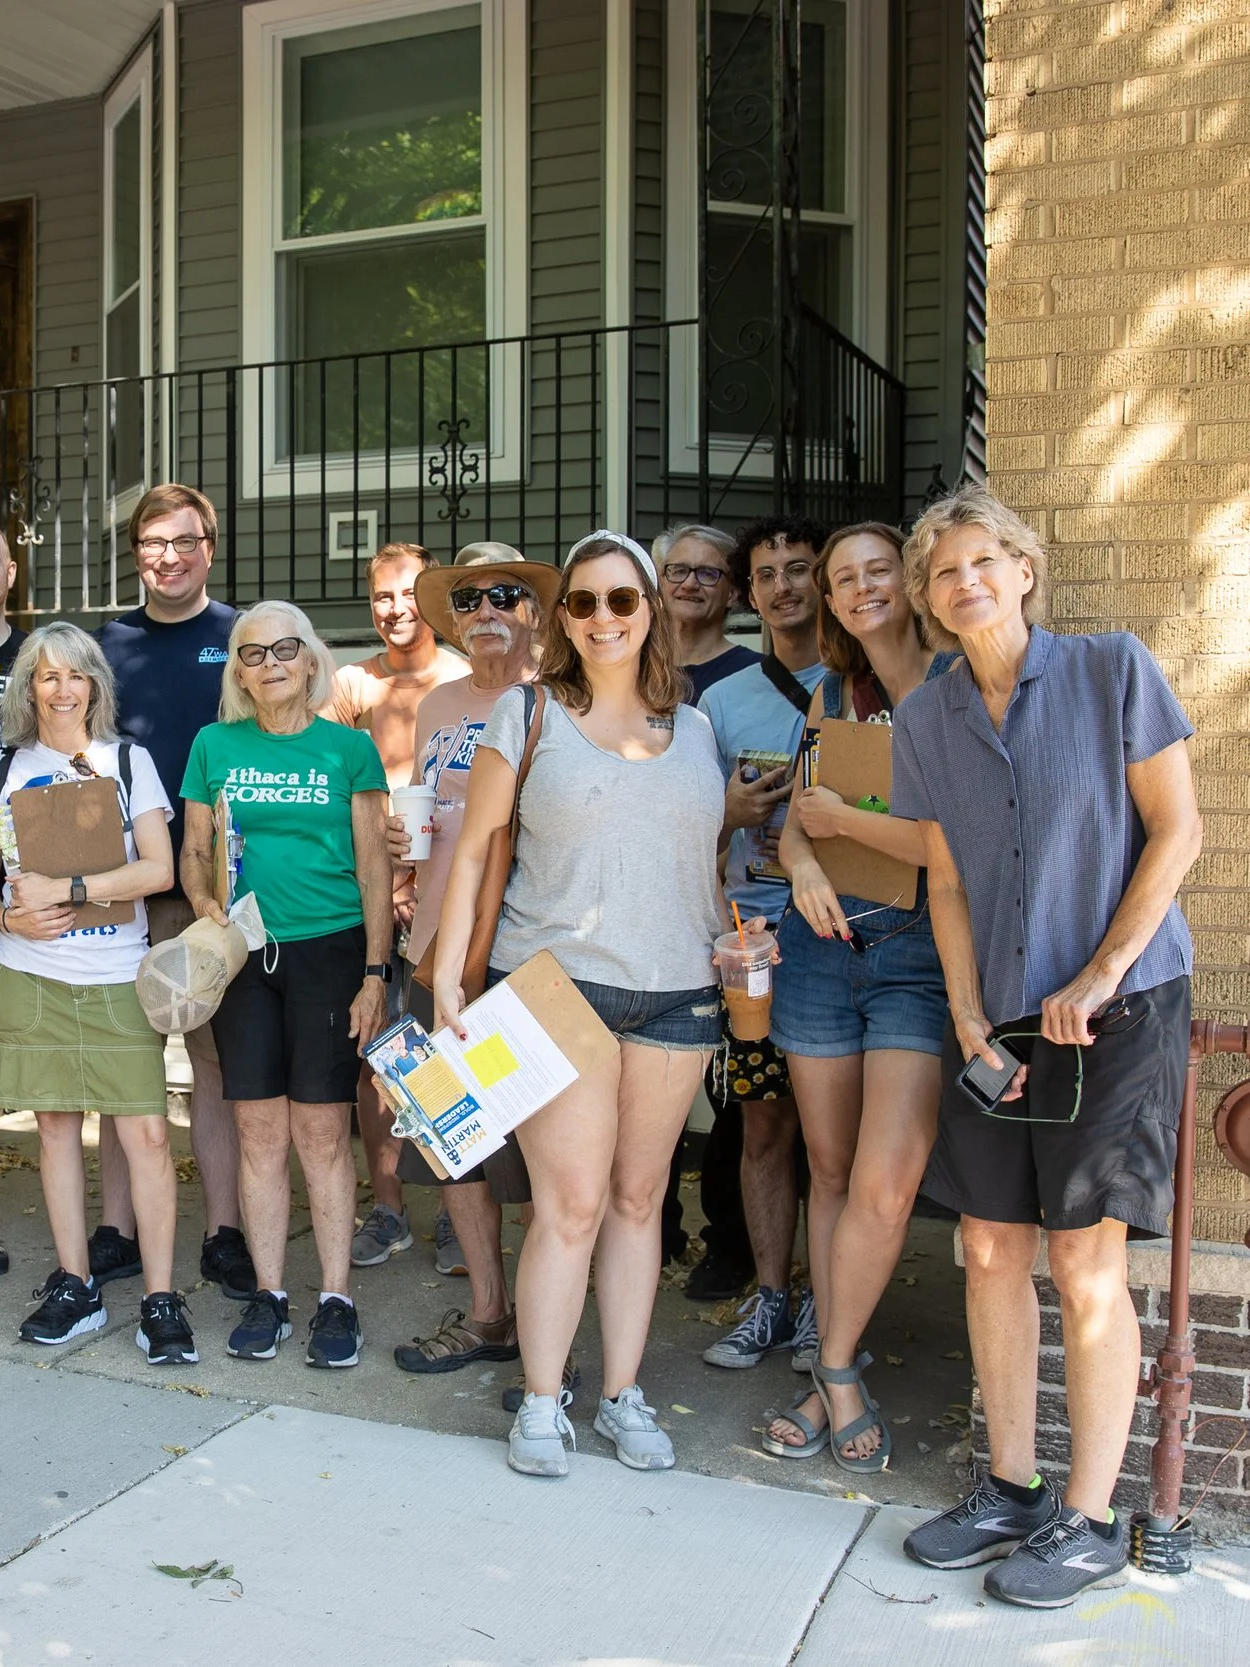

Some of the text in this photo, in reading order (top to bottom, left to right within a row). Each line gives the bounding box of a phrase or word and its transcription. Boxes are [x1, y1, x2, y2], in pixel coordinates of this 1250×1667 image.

[228, 767, 329, 786] Ithaca is
[225, 785, 330, 804] GORGES
[433, 1100, 470, 1129] LEADERSH
[456, 1128, 487, 1154] MATT
